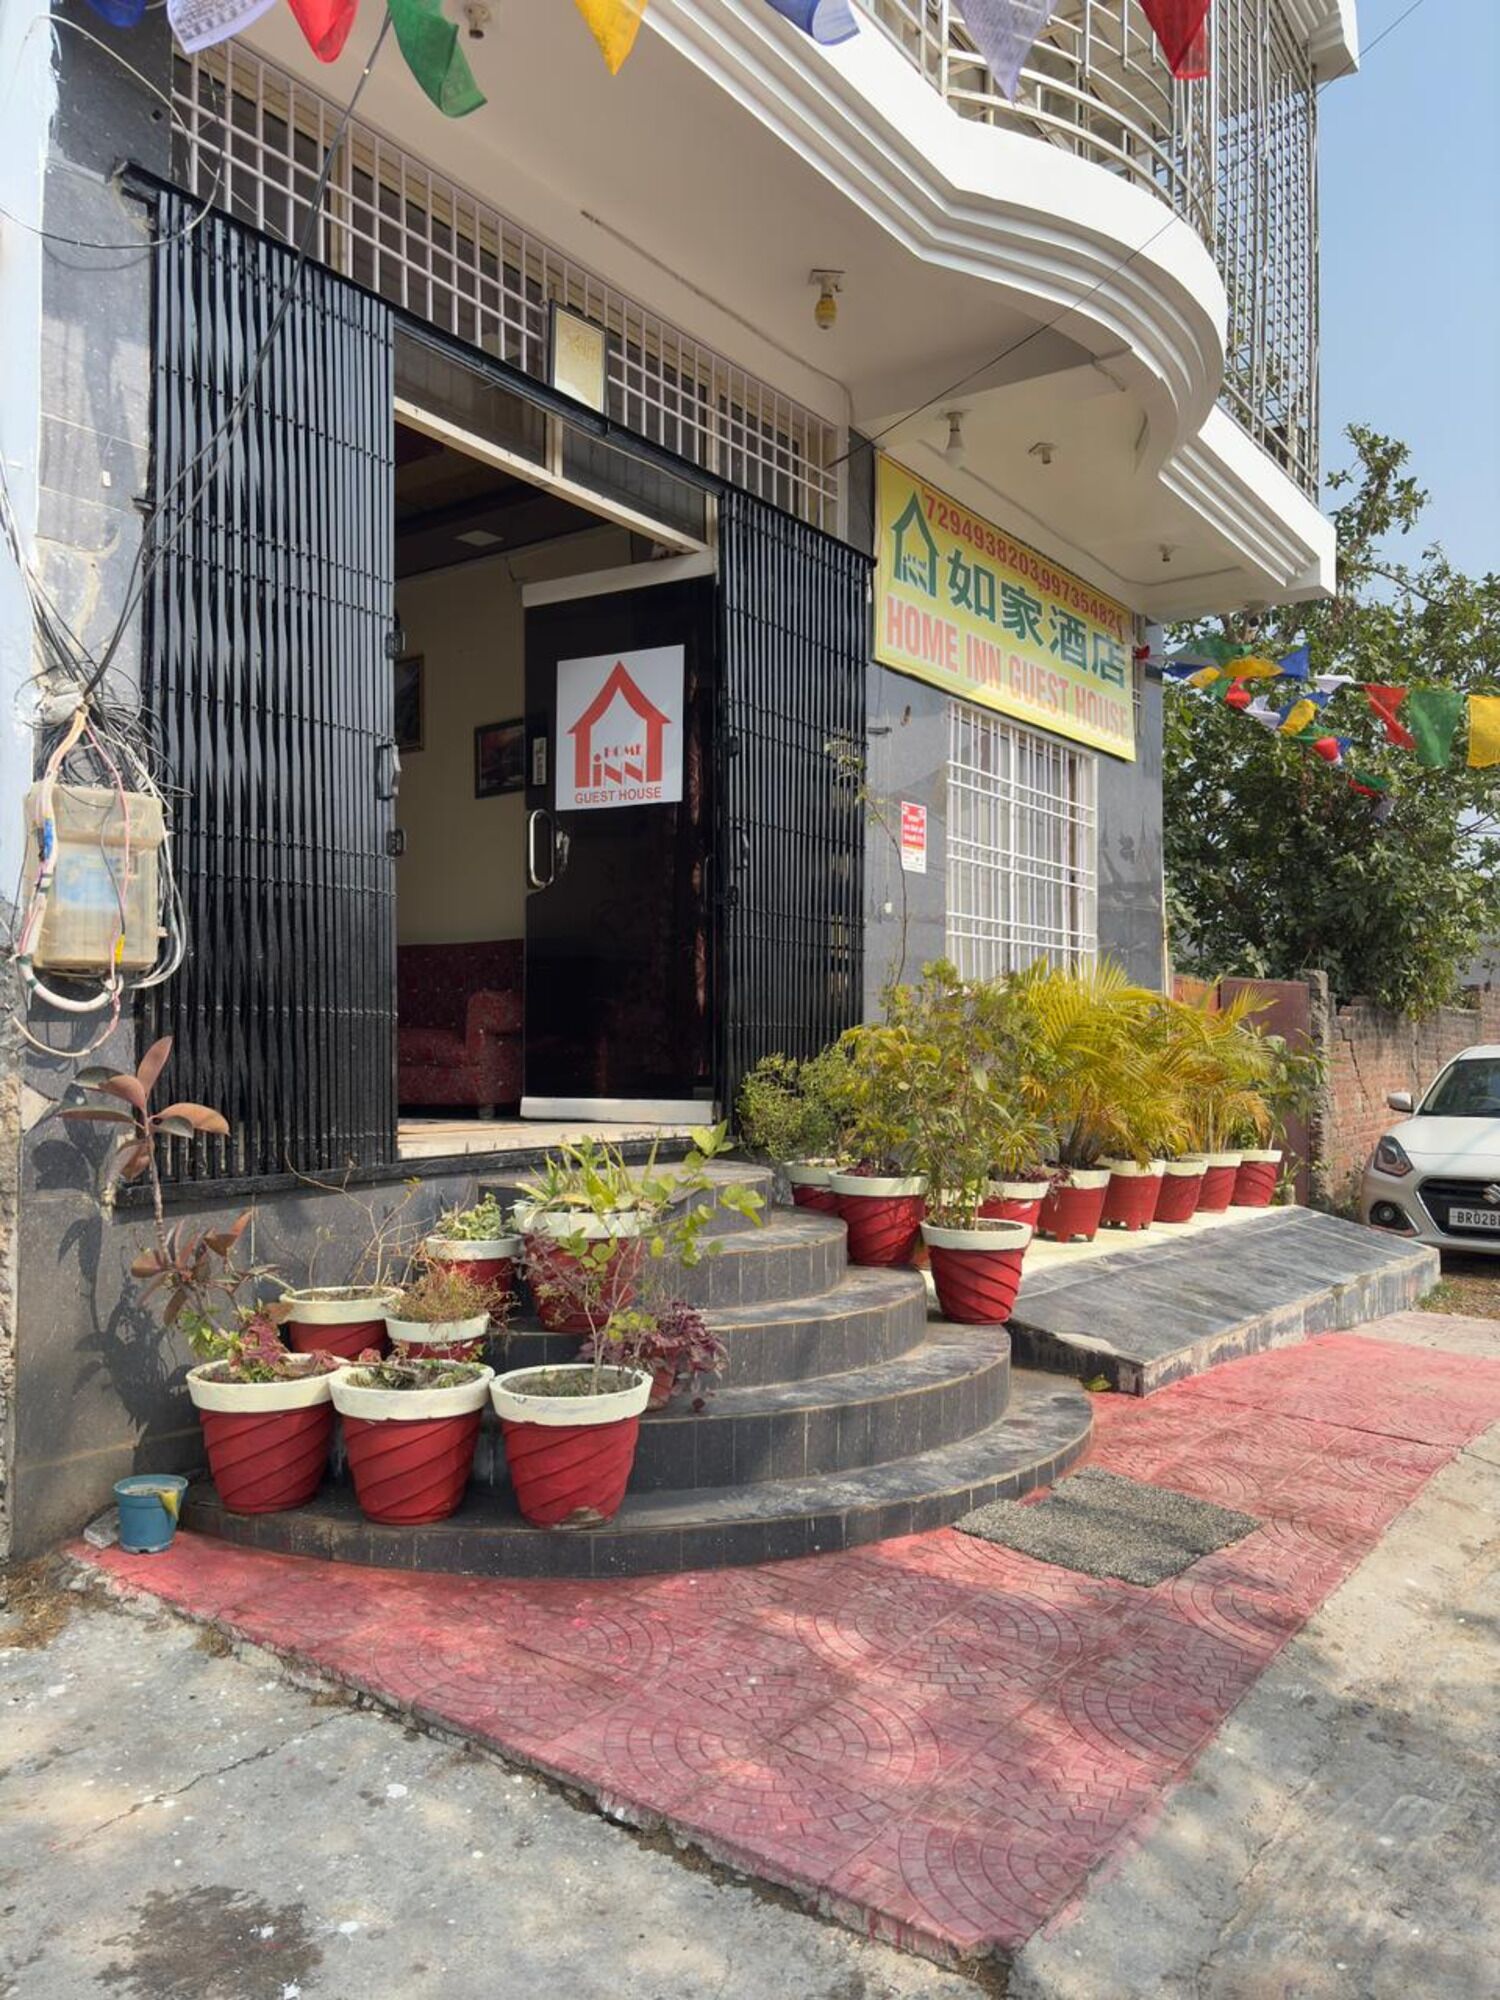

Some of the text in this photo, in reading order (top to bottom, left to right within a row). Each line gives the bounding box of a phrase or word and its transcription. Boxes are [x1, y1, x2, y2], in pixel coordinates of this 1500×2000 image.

[947, 548, 1125, 688] 如家酒店
[887, 595, 1127, 741] HOME INN GUEST HOUSE
[575, 786, 662, 804] GUEST HOUSE
[1457, 1211, 1500, 1226] BR02B
